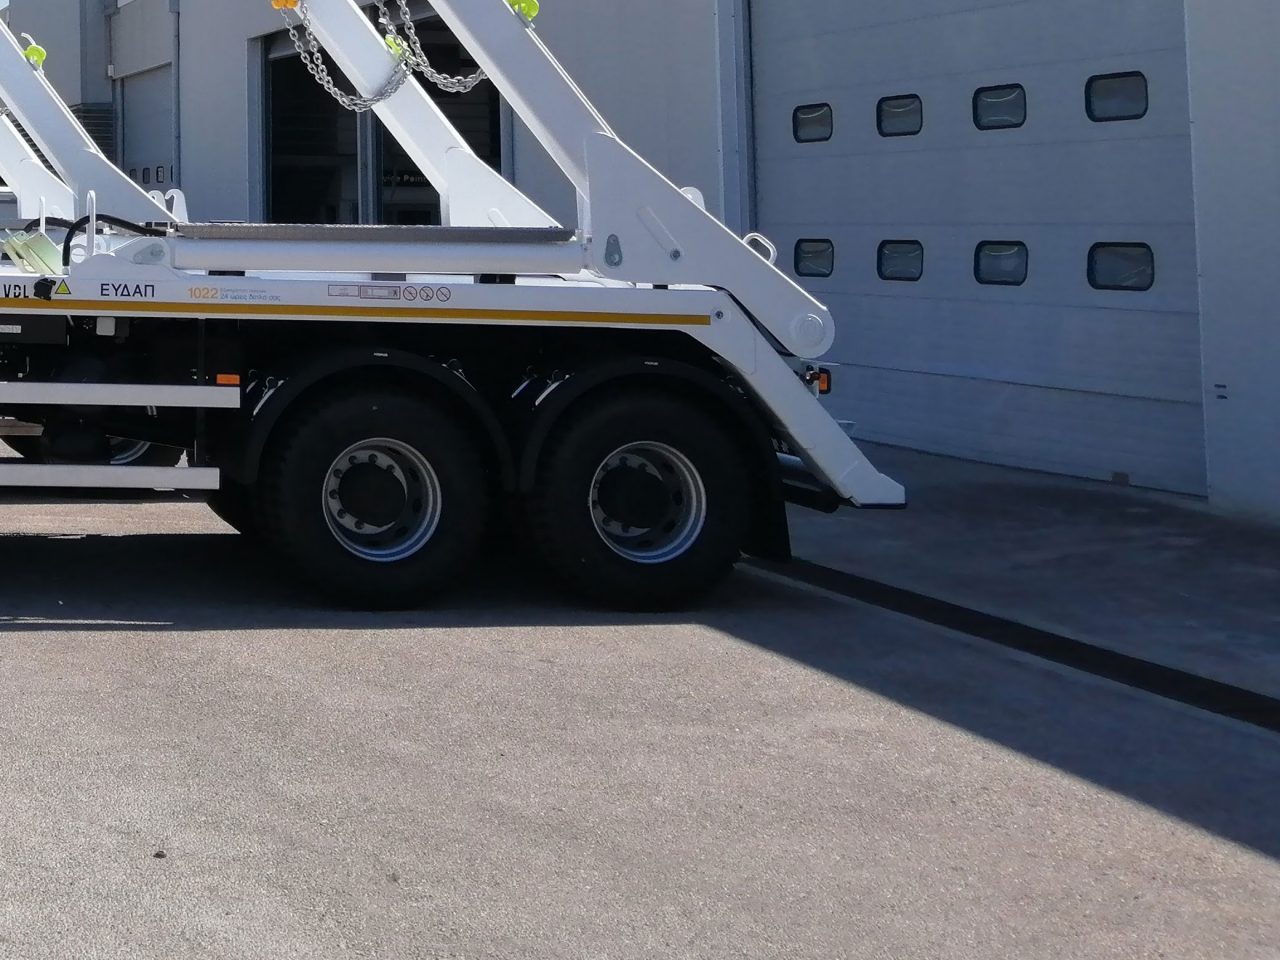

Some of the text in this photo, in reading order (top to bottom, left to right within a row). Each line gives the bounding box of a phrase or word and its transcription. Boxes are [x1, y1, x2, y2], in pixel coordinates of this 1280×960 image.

[3, 283, 30, 298] VDL
[100, 283, 155, 298] ΕΥΔΑΠ
[187, 287, 218, 299] 1022
